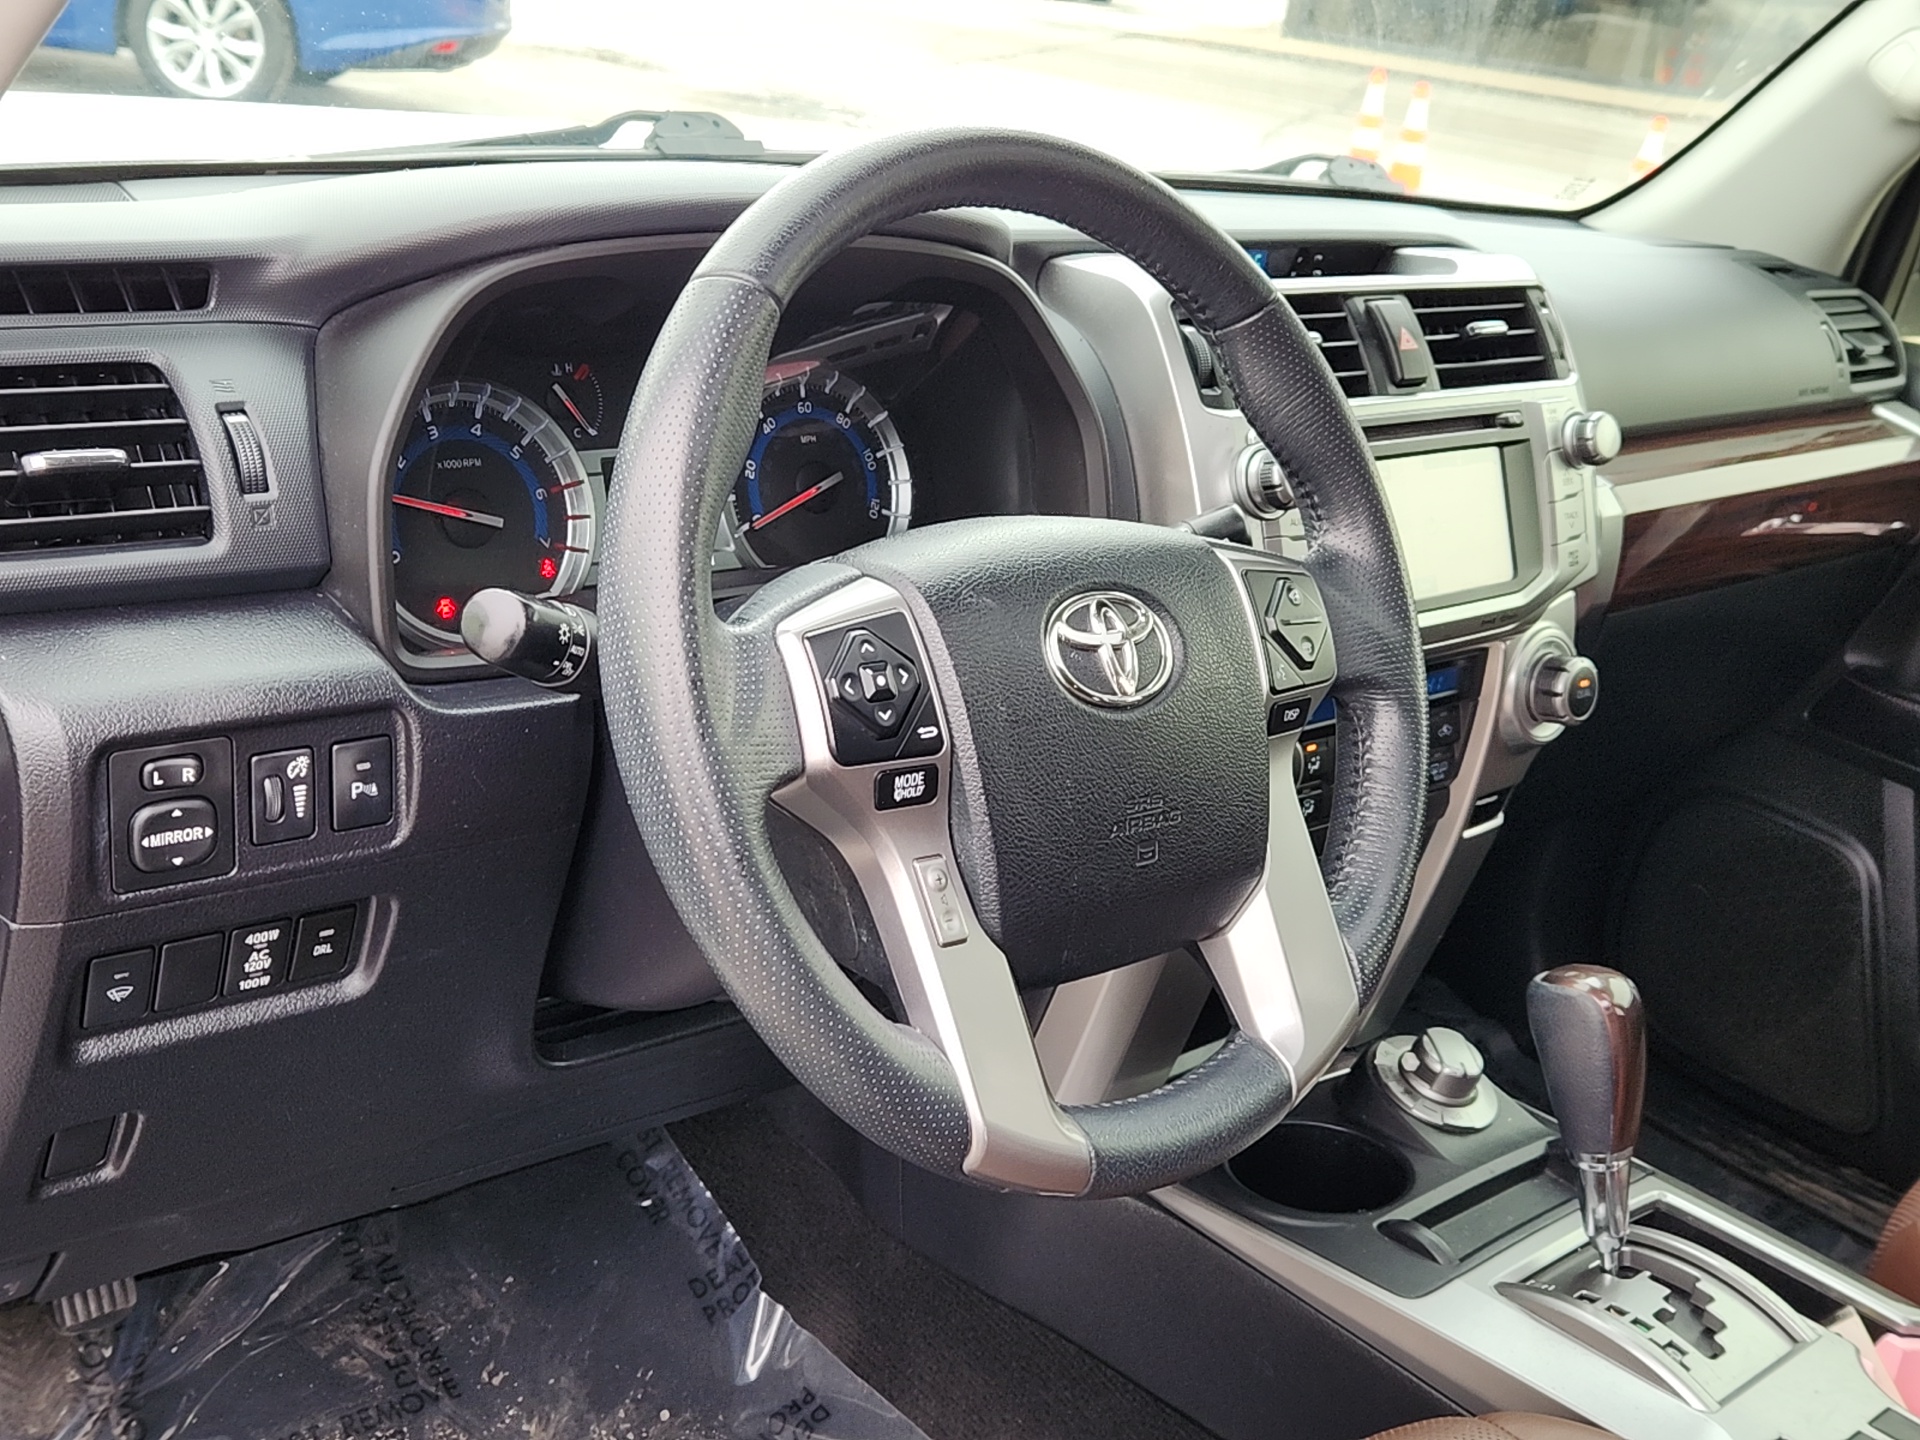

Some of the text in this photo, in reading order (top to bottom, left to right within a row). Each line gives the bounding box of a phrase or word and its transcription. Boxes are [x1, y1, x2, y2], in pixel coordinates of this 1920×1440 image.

[797, 401, 812, 414] 60
[762, 416, 777, 435] 40
[836, 412, 851, 430] 80
[427, 425, 439, 440] 3
[470, 423, 483, 437] 4
[800, 435, 817, 444] MPH
[510, 445, 523, 460] 5
[863, 448, 878, 471] 100
[744, 460, 757, 479] 20
[535, 488, 548, 501] 6
[869, 498, 881, 520] 120
[539, 537, 551, 549] 7
[1284, 708, 1300, 722] DISP
[152, 767, 196, 786] L R
[894, 771, 926, 788] MODE
[350, 781, 363, 800] P
[150, 827, 204, 848] MIRROR
[244, 928, 280, 945] 400W
[248, 949, 271, 962] AC
[312, 942, 333, 957] DRL
[243, 958, 272, 974] 120V
[238, 974, 271, 991] 100W
